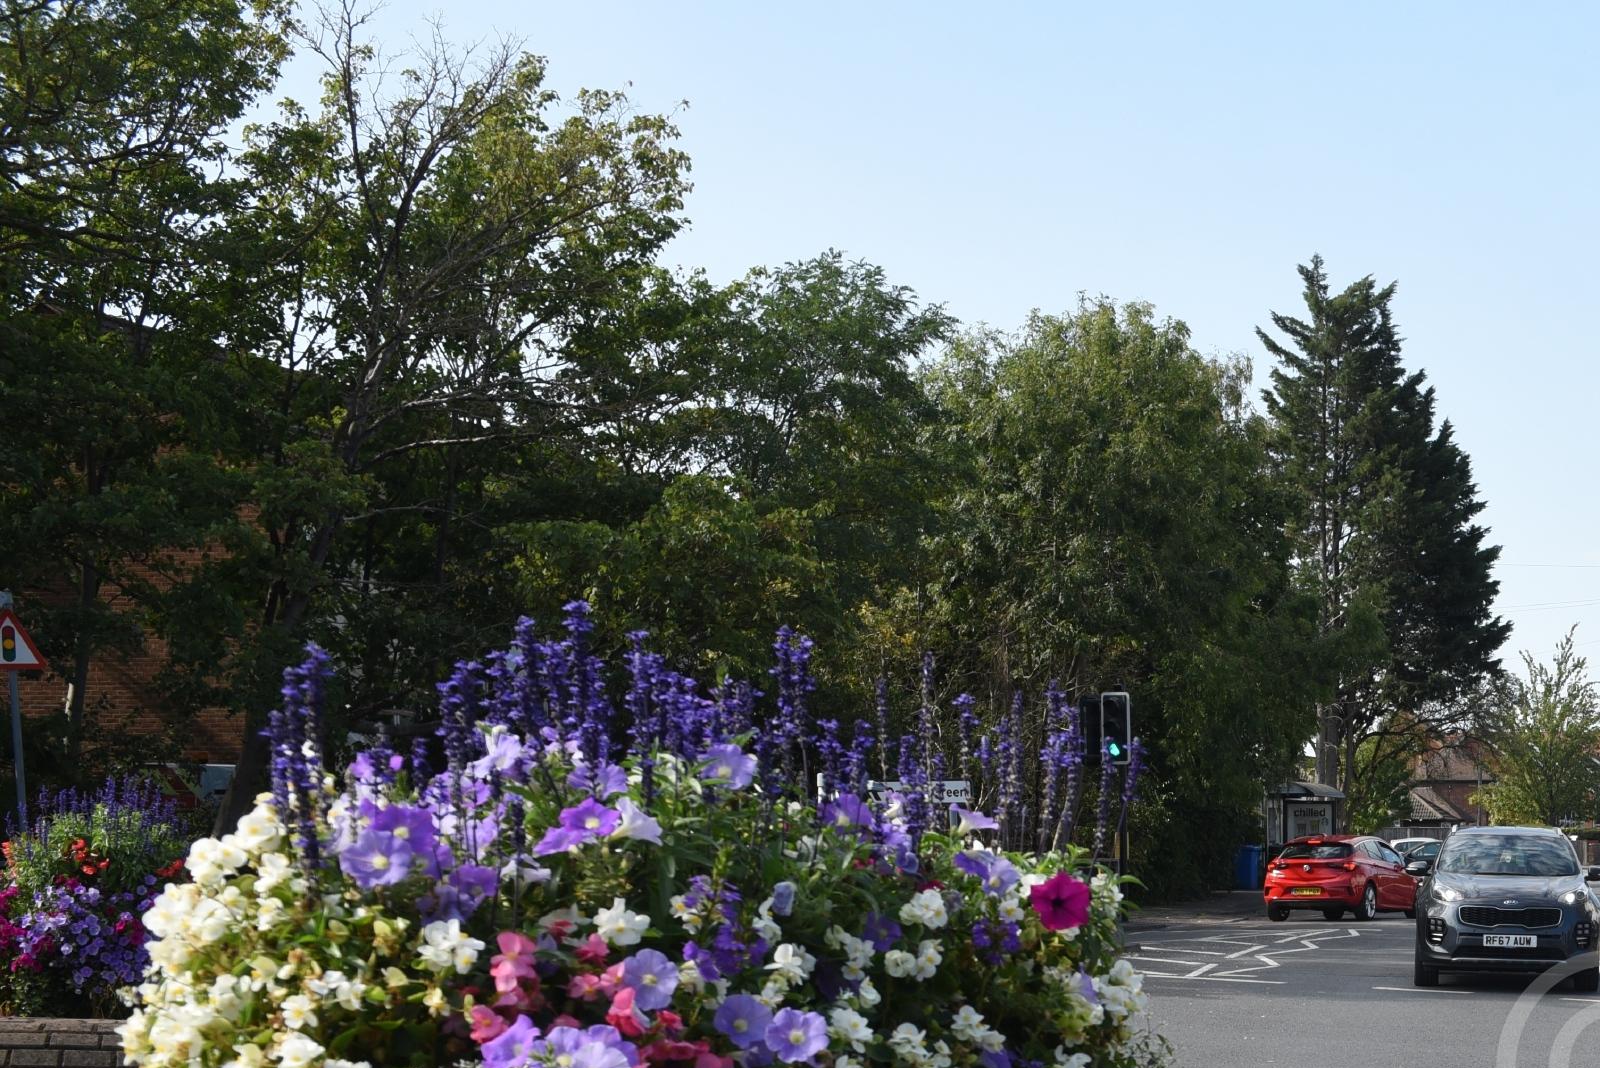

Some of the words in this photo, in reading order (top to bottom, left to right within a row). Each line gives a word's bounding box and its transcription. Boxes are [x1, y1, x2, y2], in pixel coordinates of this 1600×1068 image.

[1294, 807, 1326, 817] chilled
[1485, 935, 1511, 945] RF67
[1513, 936, 1532, 946] AUW
